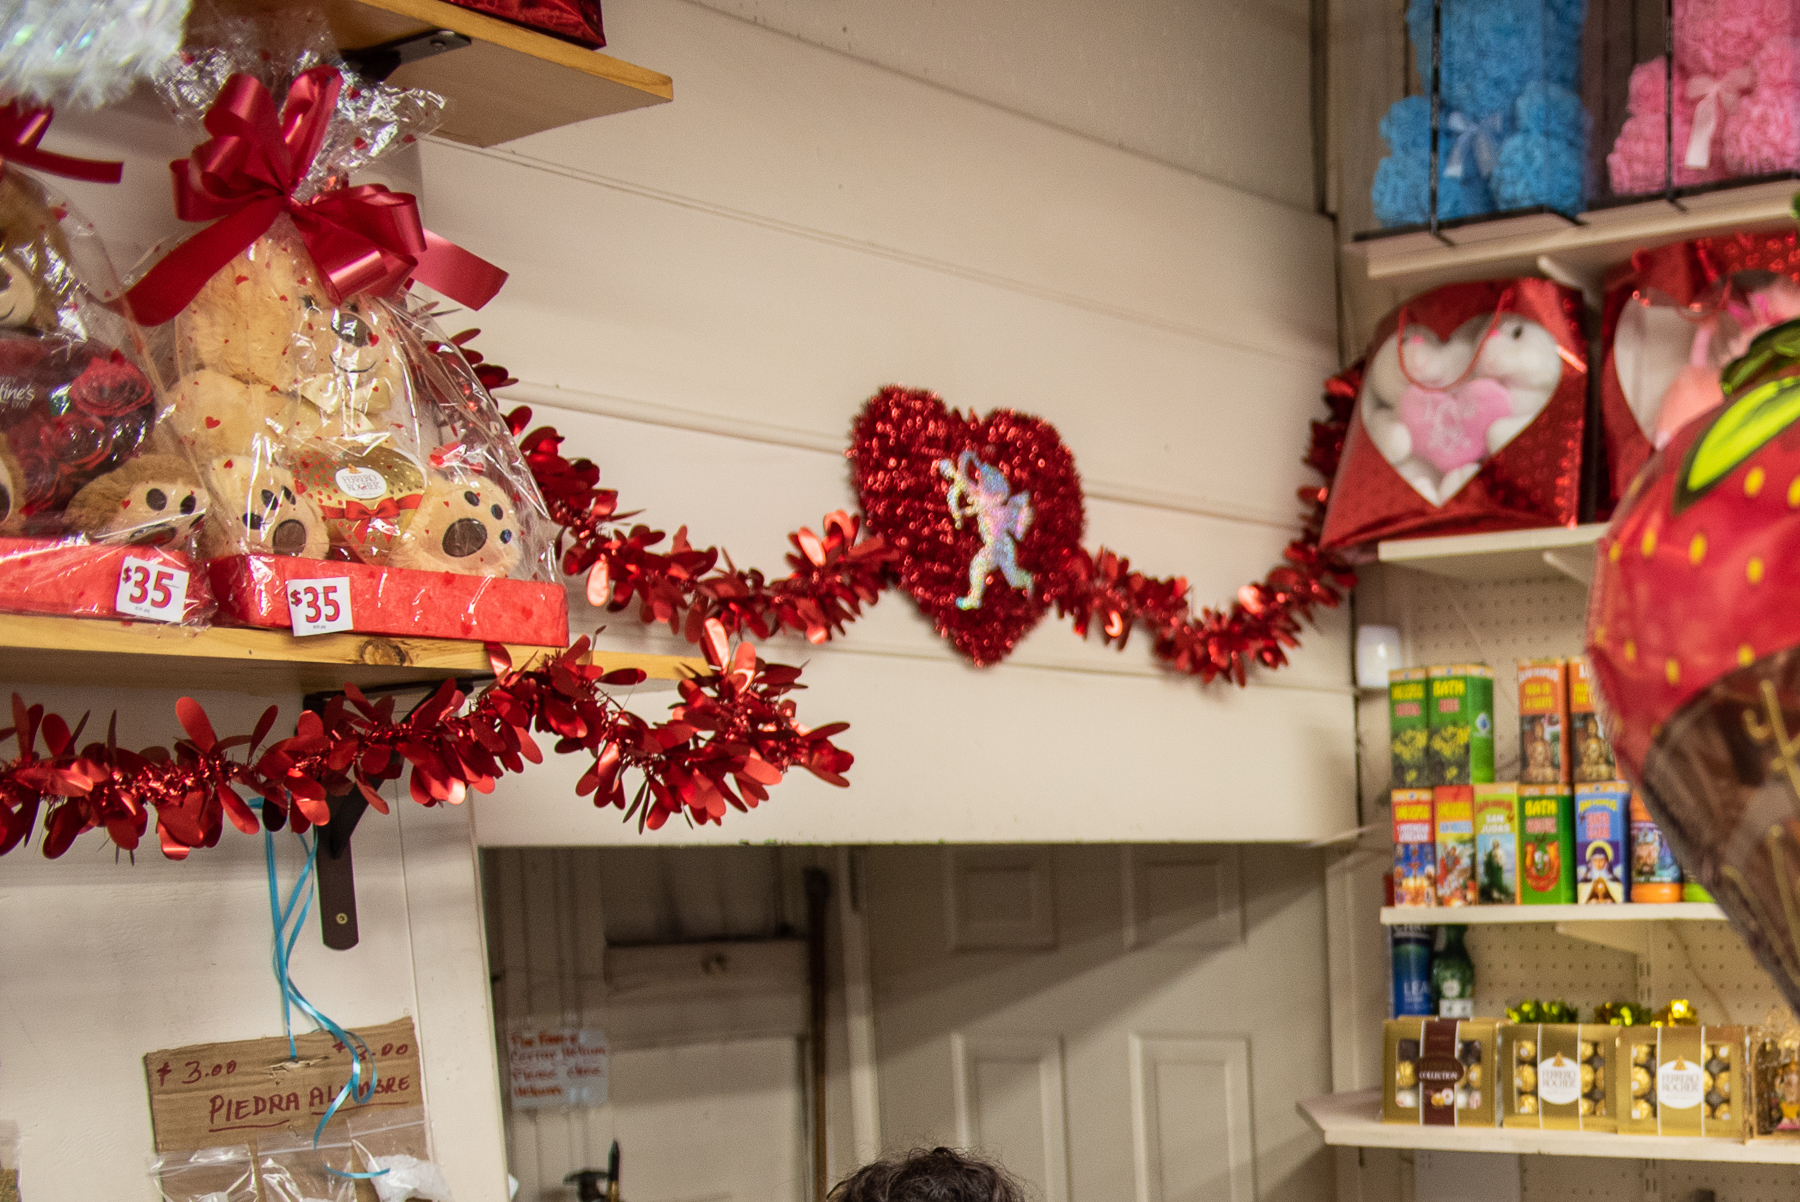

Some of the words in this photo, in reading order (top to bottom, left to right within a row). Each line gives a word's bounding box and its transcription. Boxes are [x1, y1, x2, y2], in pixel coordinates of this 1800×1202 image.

[342, 474, 377, 484] FERRERO
[122, 565, 174, 609] $35
[290, 585, 341, 624] $35
[1433, 680, 1466, 698] BATH
[1525, 799, 1558, 817] BATH
[1419, 1070, 1458, 1081] COLLECTION
[1542, 1069, 1576, 1079] FERRERO
[1662, 1074, 1699, 1084] FERRERO
[1542, 1079, 1576, 1089] ROCHER
[1662, 1083, 1699, 1093] ROCHER
[209, 1093, 300, 1124] PIEDRA
